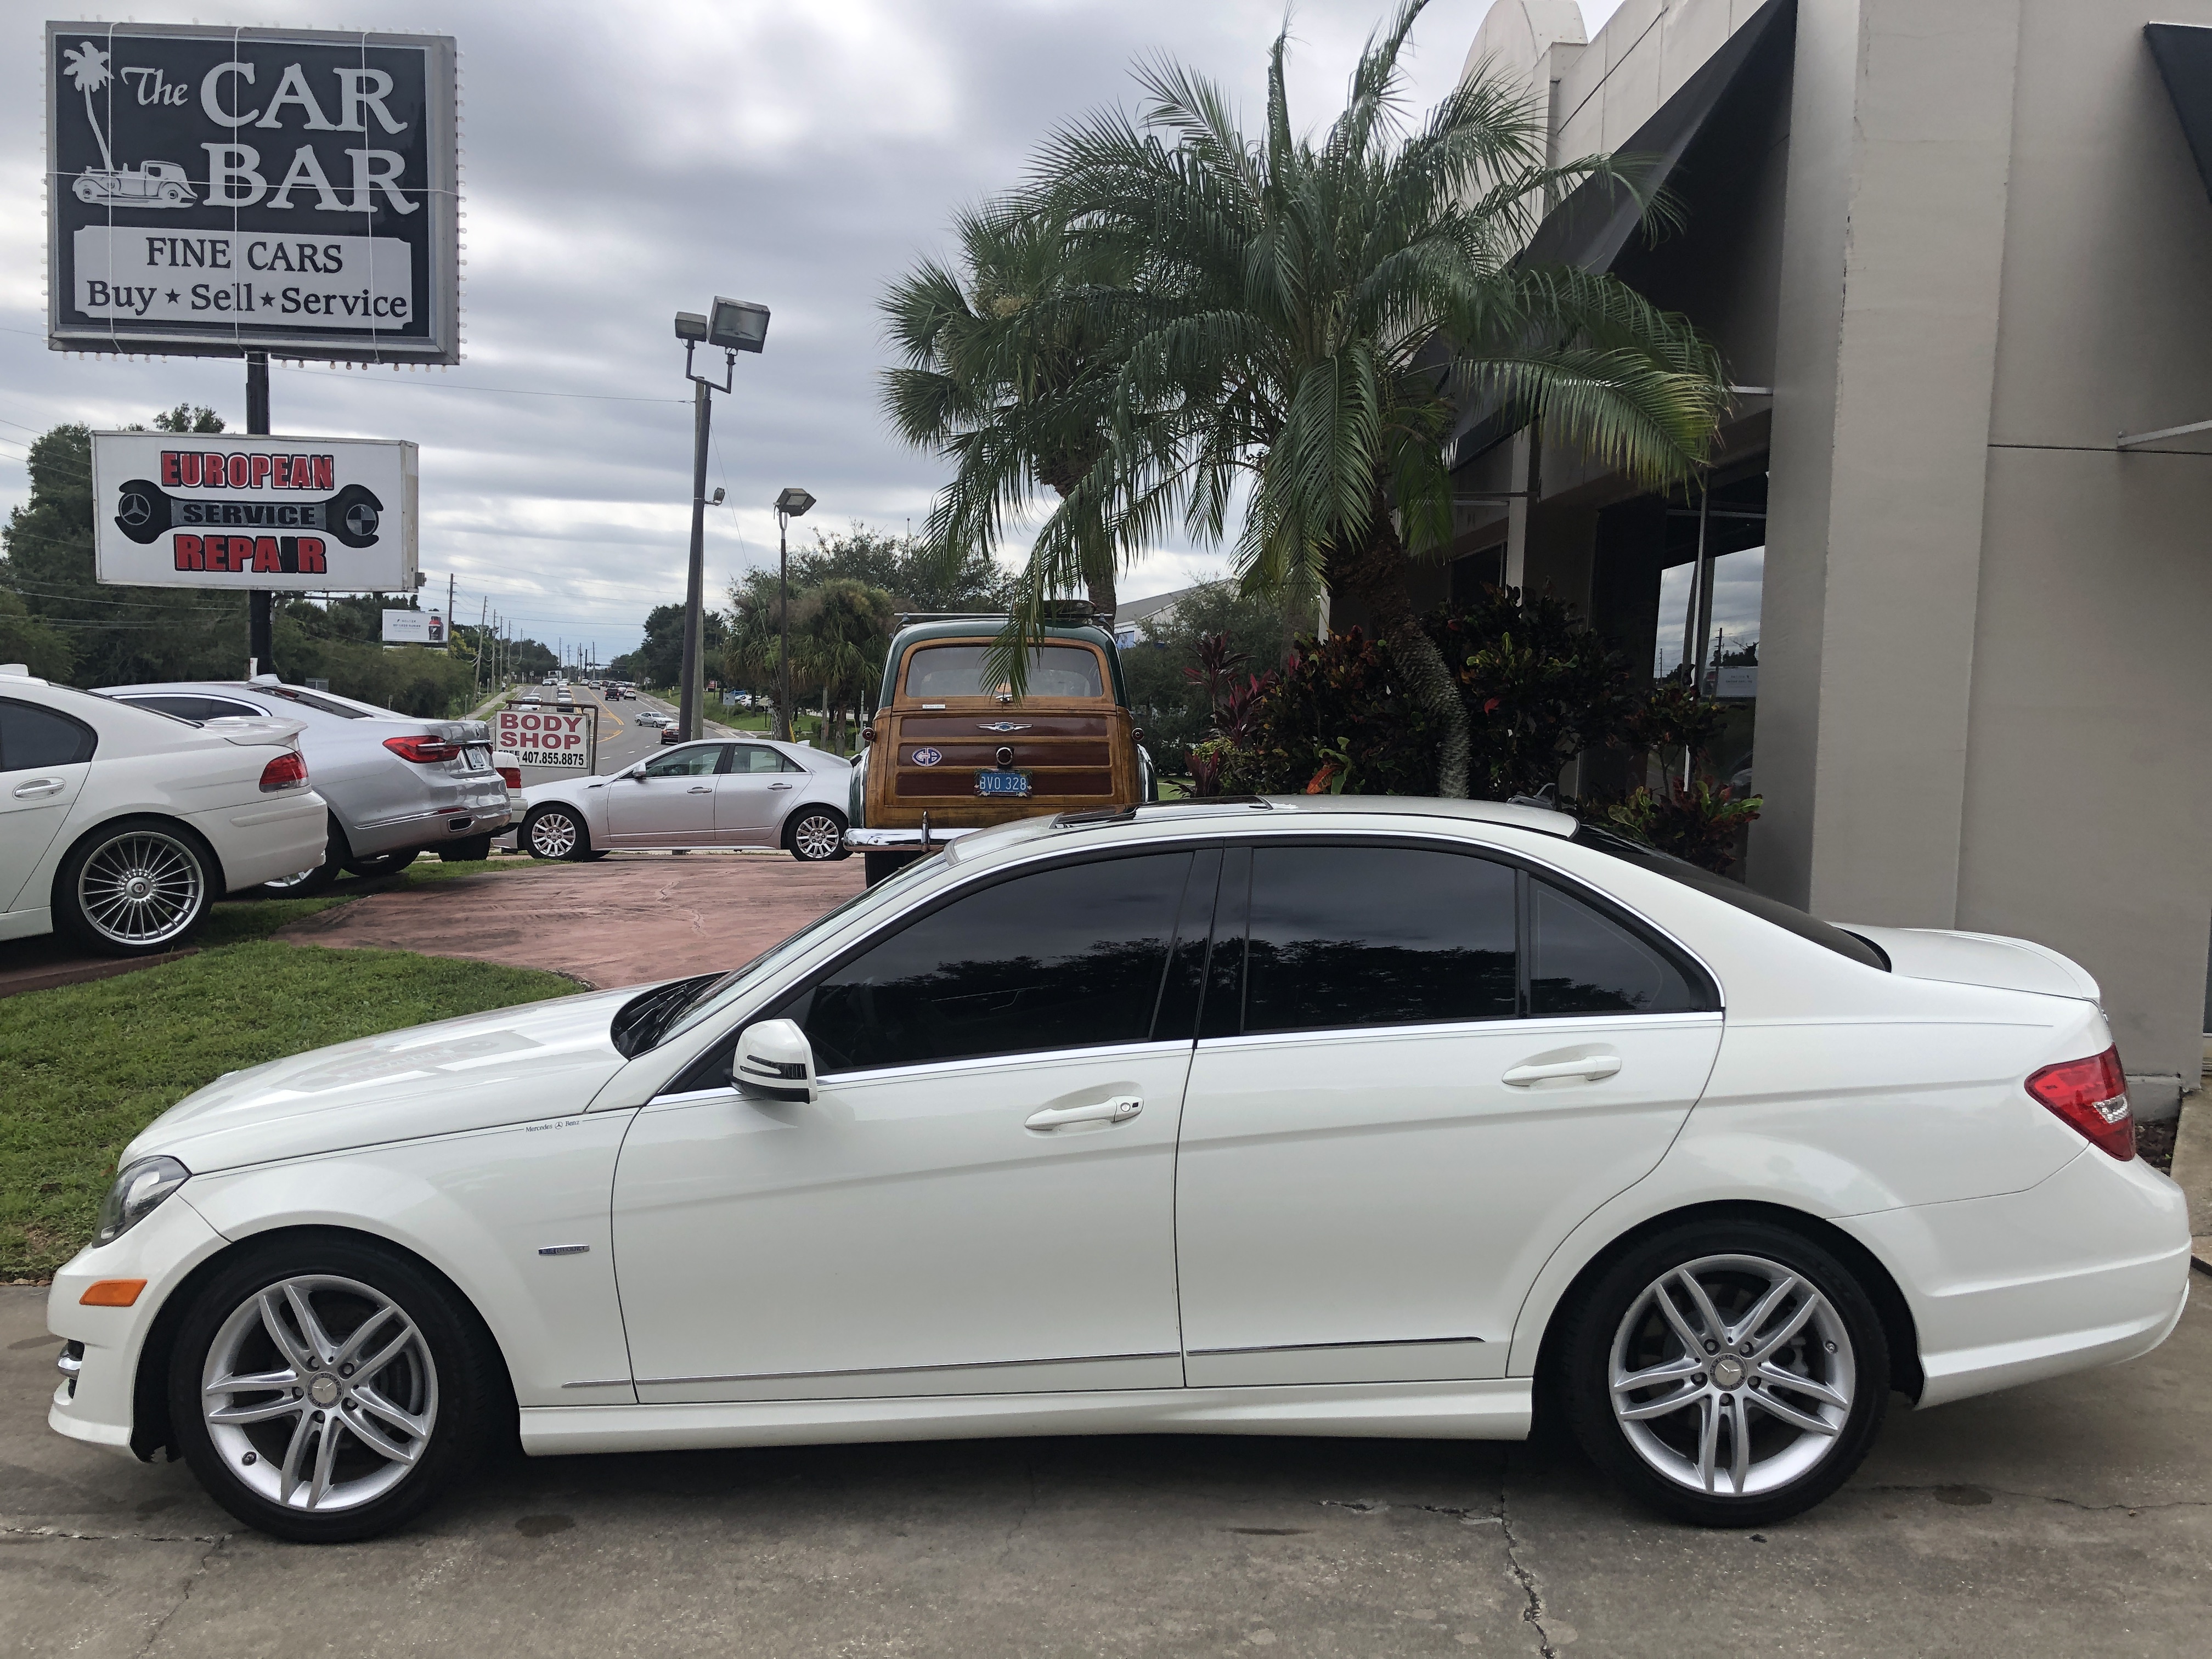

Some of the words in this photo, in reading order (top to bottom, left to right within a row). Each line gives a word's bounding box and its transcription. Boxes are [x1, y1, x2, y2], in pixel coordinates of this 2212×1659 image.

[120, 66, 188, 106] The
[200, 61, 408, 134] CAR
[200, 142, 420, 215] BAR
[146, 237, 231, 269] FINE
[247, 241, 343, 273] CARS
[87, 280, 157, 316] Buy
[191, 283, 255, 312] Sell
[281, 287, 407, 318] Service
[161, 450, 334, 490] EUROPEAN
[183, 504, 316, 525] SERVICE
[173, 534, 327, 574] REPAIR
[500, 713, 583, 732] BODY
[500, 731, 581, 749] SHOP
[522, 751, 584, 765] 407.855.8875
[1006, 777, 1026, 790] 328
[526, 1124, 552, 1132] Mercedes
